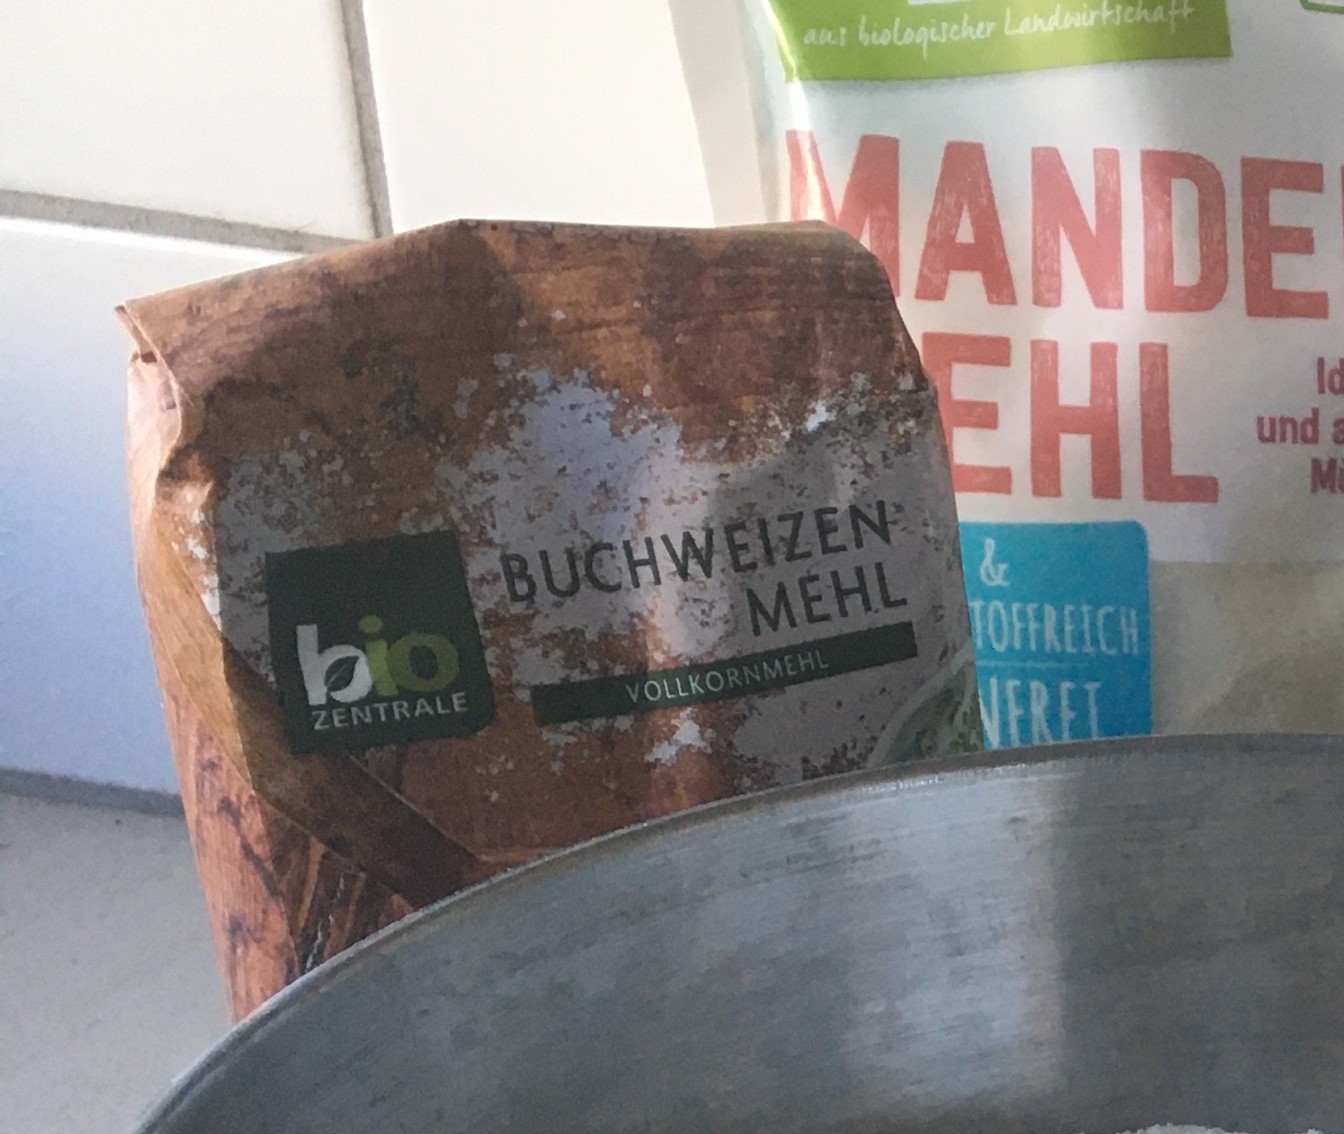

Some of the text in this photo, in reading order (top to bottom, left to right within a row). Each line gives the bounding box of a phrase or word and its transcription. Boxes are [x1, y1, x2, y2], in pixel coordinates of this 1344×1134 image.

[803, 3, 1193, 60] aus biologischer Landwirtschaft
[922, 332, 1219, 505] EHL
[1256, 408, 1320, 445] und
[500, 498, 894, 605] BUCHWEIZEN
[979, 537, 1010, 587] &
[744, 561, 909, 638] MEHL
[296, 614, 461, 706] bio
[625, 649, 832, 704] VOLLKORNMEHL
[311, 690, 470, 732] ZENTRALE
